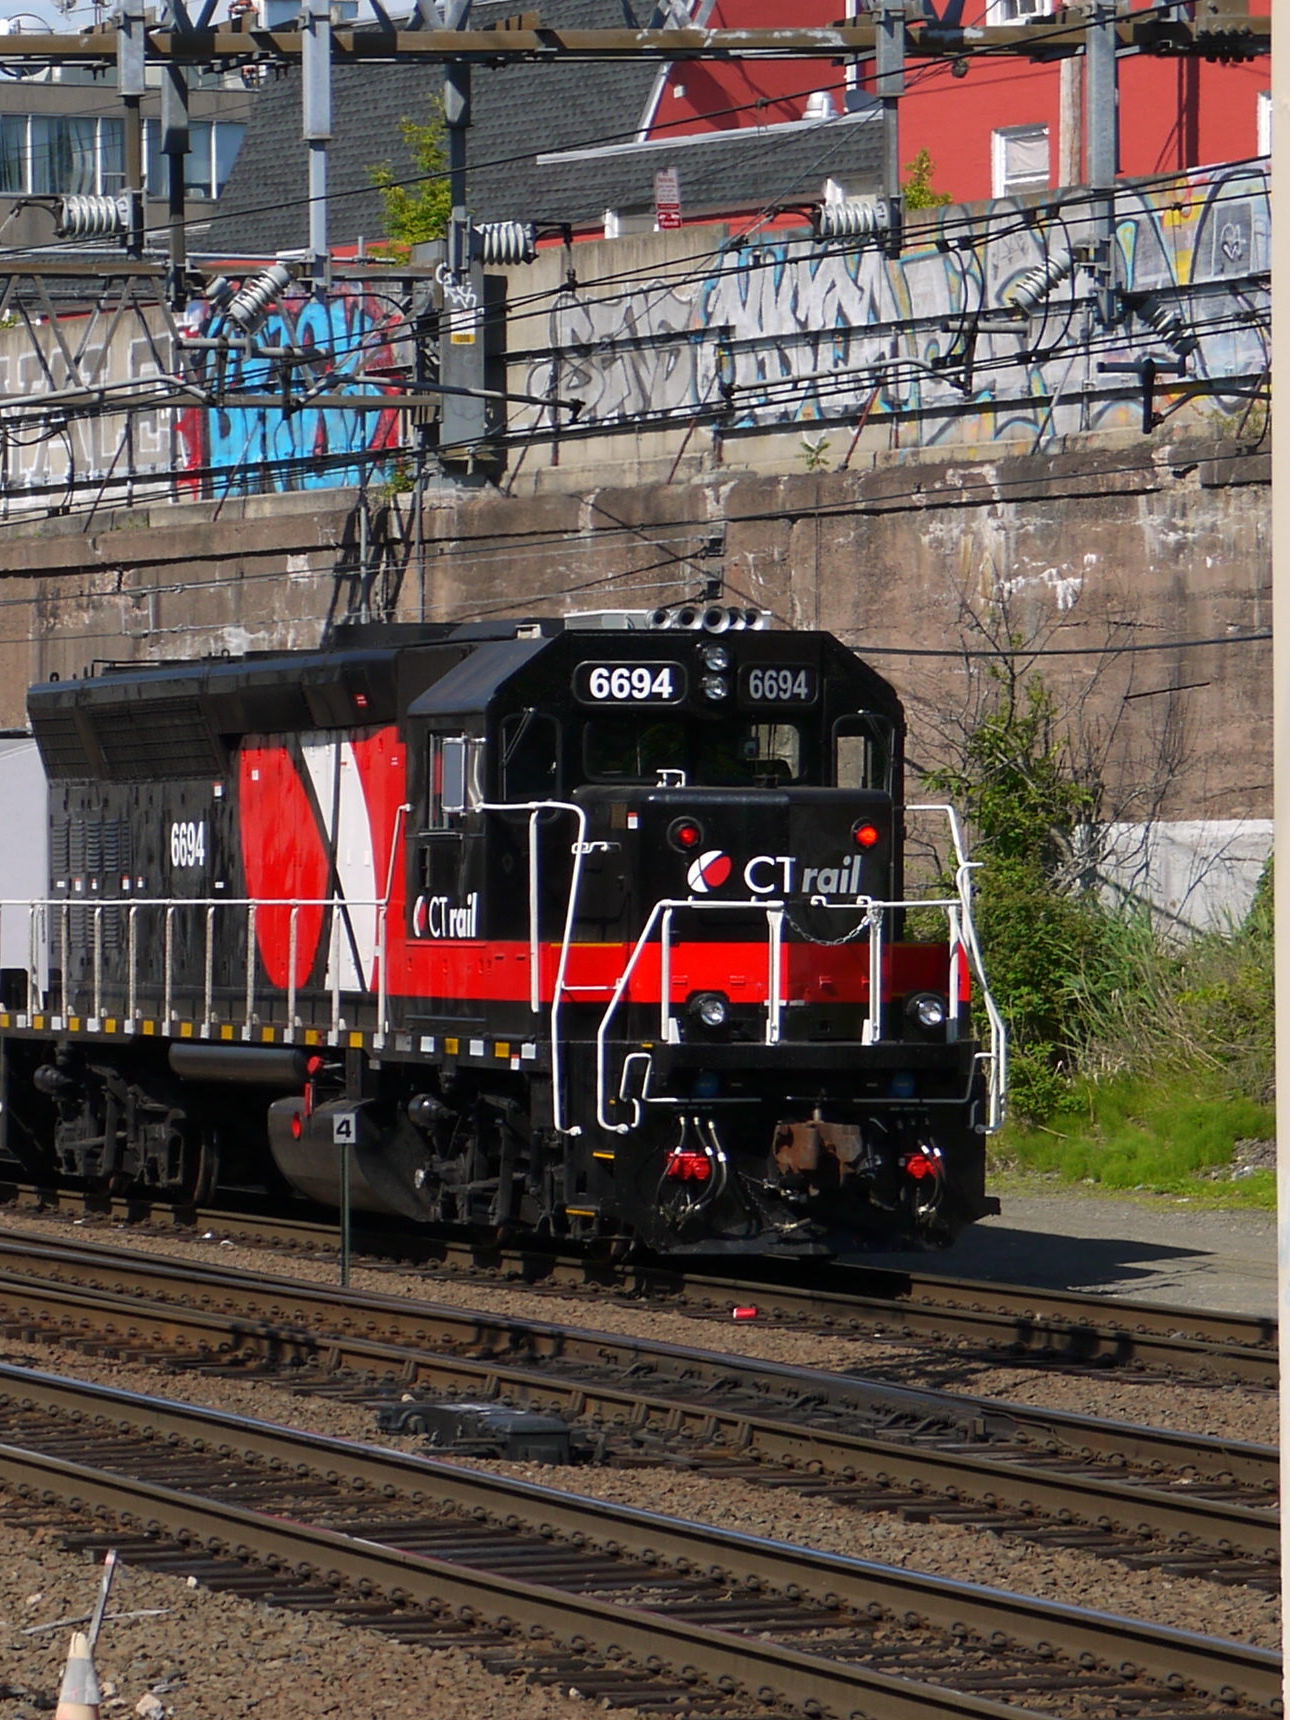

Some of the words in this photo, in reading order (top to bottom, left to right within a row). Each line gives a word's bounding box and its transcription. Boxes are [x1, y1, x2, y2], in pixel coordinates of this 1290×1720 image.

[589, 668, 673, 699] 6694
[749, 669, 808, 700] 6694
[170, 821, 205, 867] 6694
[336, 1119, 352, 1138] 4
